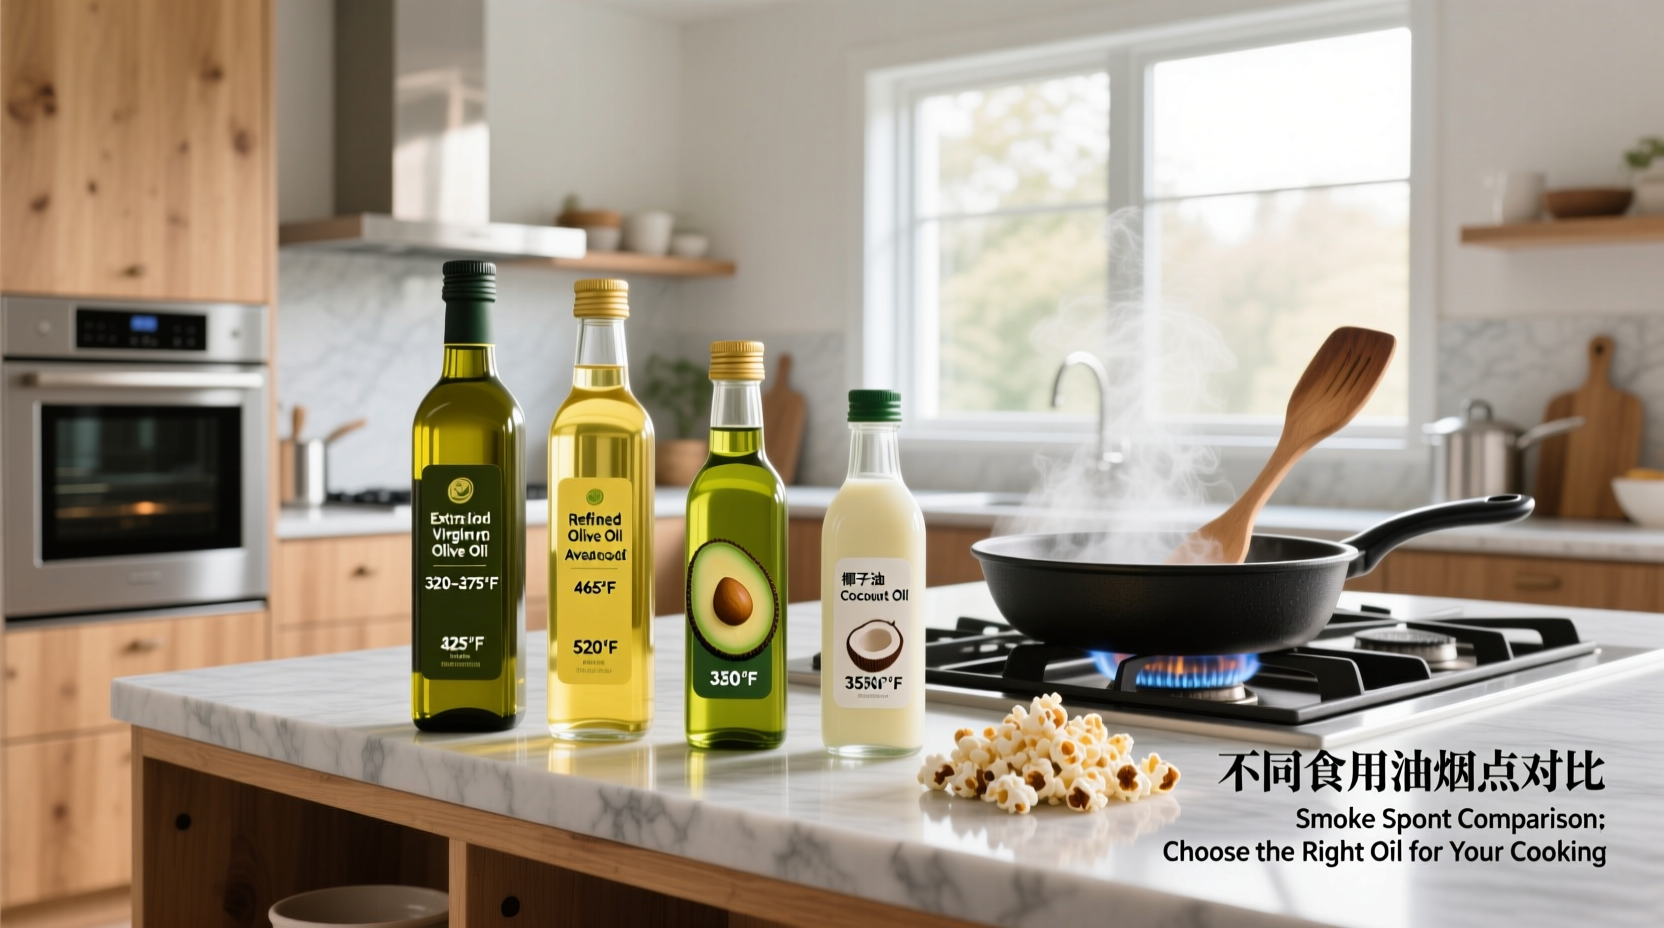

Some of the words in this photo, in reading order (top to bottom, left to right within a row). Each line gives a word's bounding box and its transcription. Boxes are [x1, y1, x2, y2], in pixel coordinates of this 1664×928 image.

[569, 512, 622, 526] Refined
[567, 528, 601, 542] Olive
[604, 529, 623, 542] Oil
[431, 543, 465, 557] Olive
[469, 544, 488, 557] Oil
[892, 588, 909, 602] Oil
